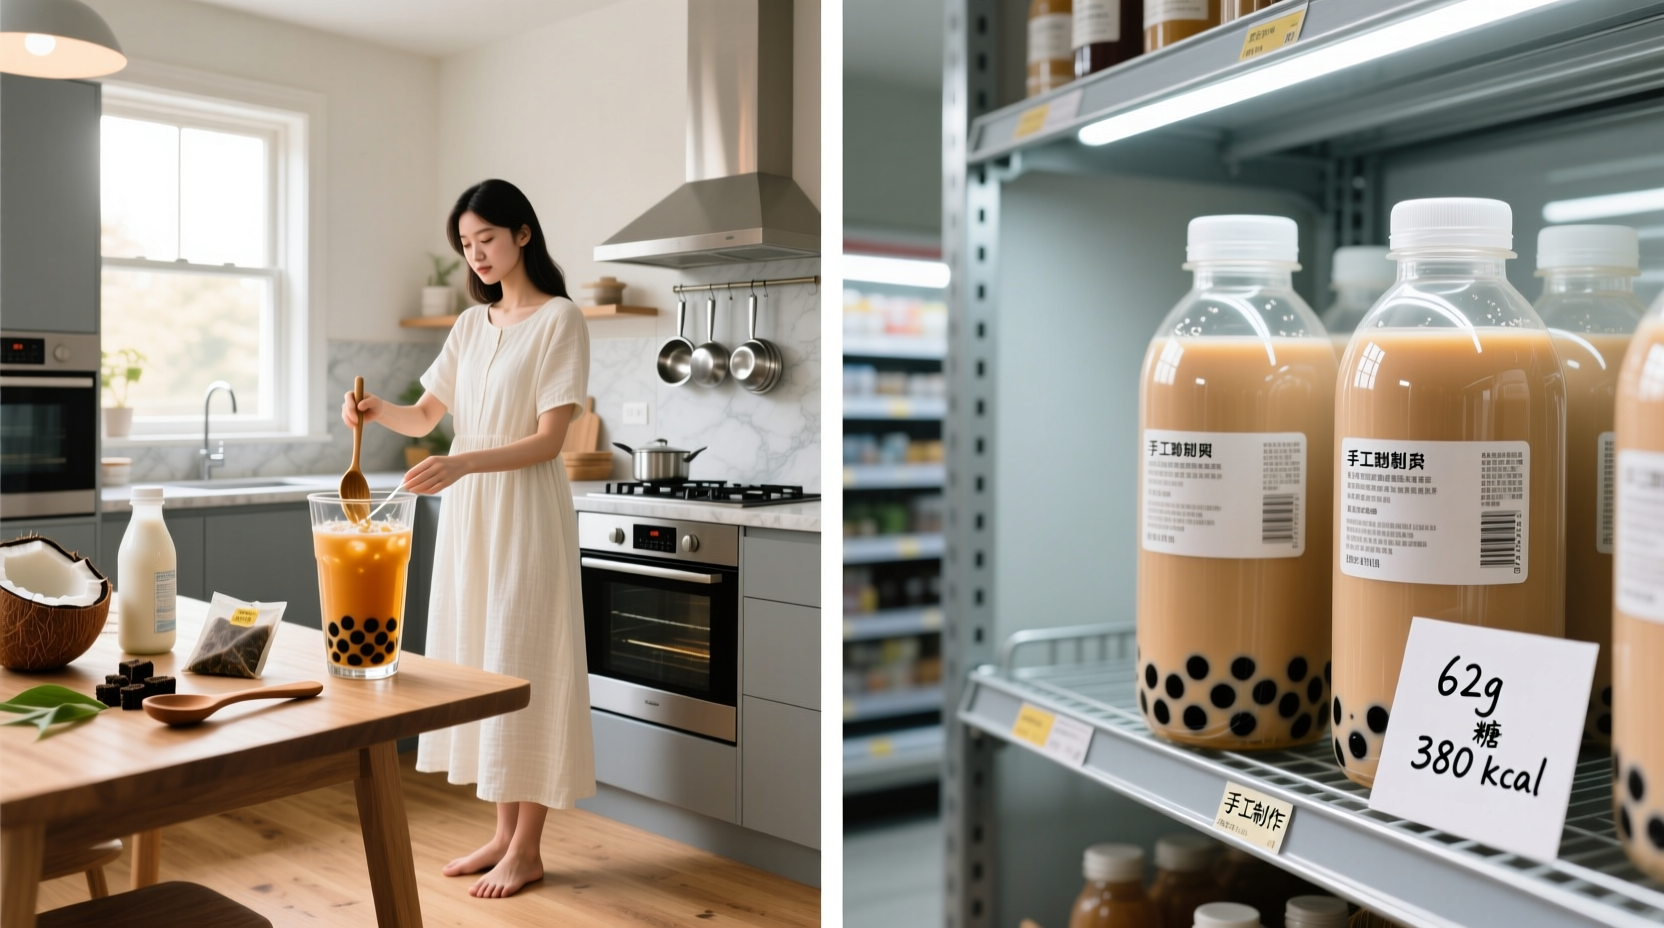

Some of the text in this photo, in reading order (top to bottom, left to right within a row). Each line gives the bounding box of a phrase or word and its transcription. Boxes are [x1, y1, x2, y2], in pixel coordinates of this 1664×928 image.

[1437, 655, 1503, 718] 62g
[1472, 720, 1502, 748] 糖
[1410, 735, 1547, 797] 380 kcal
[1224, 791, 1286, 831] 手工制作
